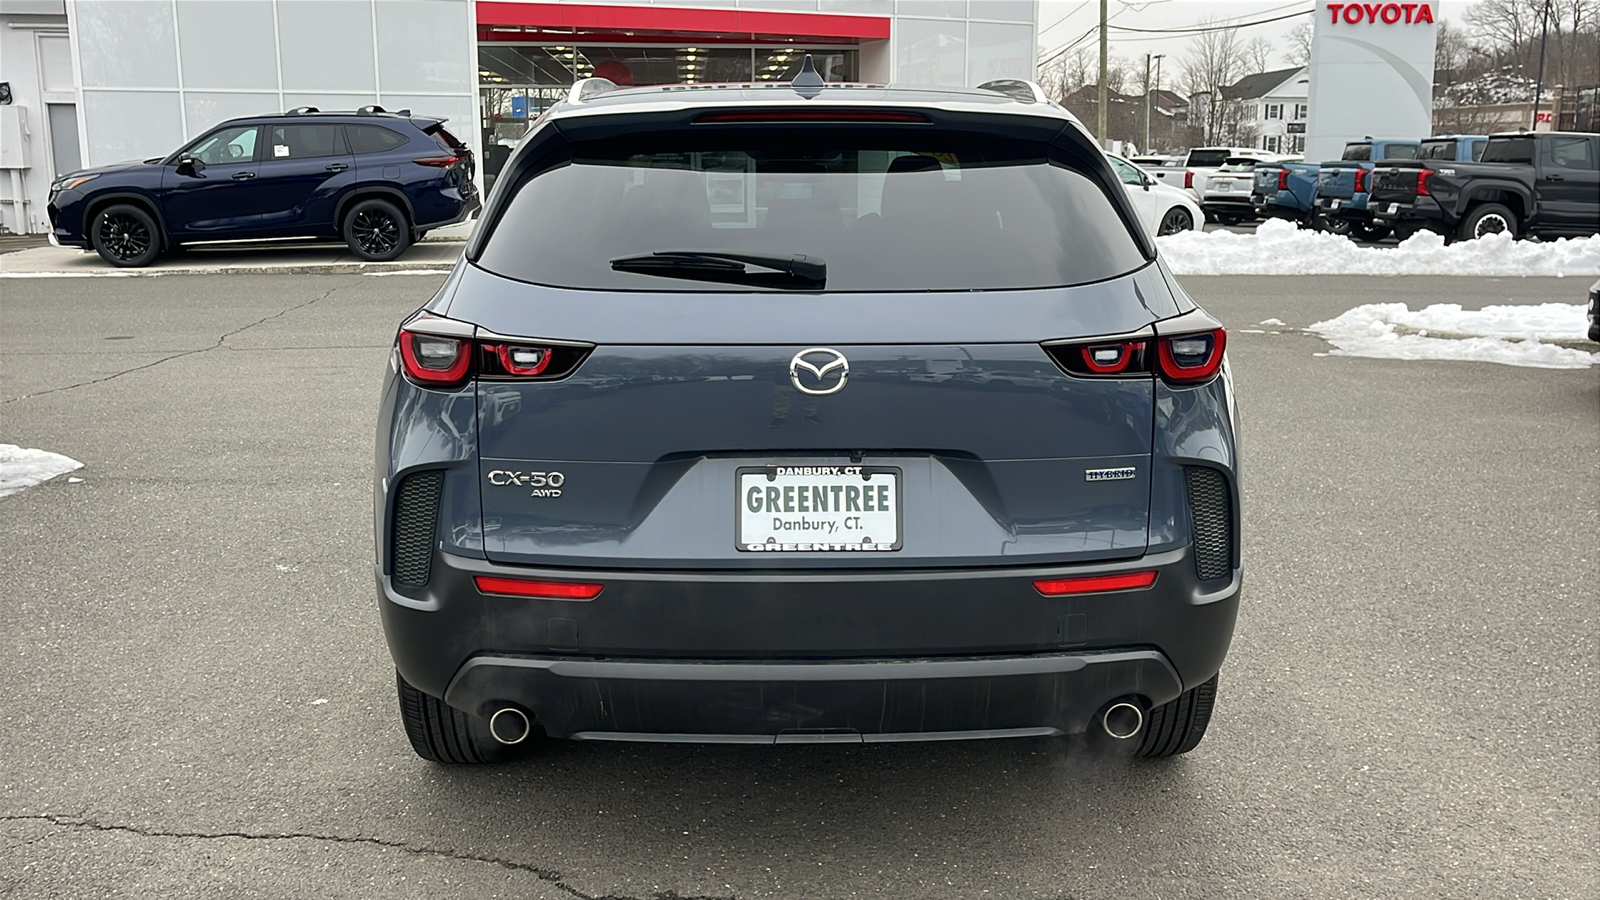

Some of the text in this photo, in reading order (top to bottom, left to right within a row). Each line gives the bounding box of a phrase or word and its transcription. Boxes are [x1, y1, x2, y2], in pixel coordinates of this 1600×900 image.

[1327, 3, 1434, 24] TOYOTA
[487, 470, 565, 487] CX-50
[777, 467, 862, 476] DANBURY, CT
[1087, 468, 1135, 479] HYBRID
[531, 489, 562, 497] AWD
[747, 485, 889, 513] GREENTREE
[773, 516, 863, 534] Danbury, CT.
[747, 543, 892, 551] GREENTREE
